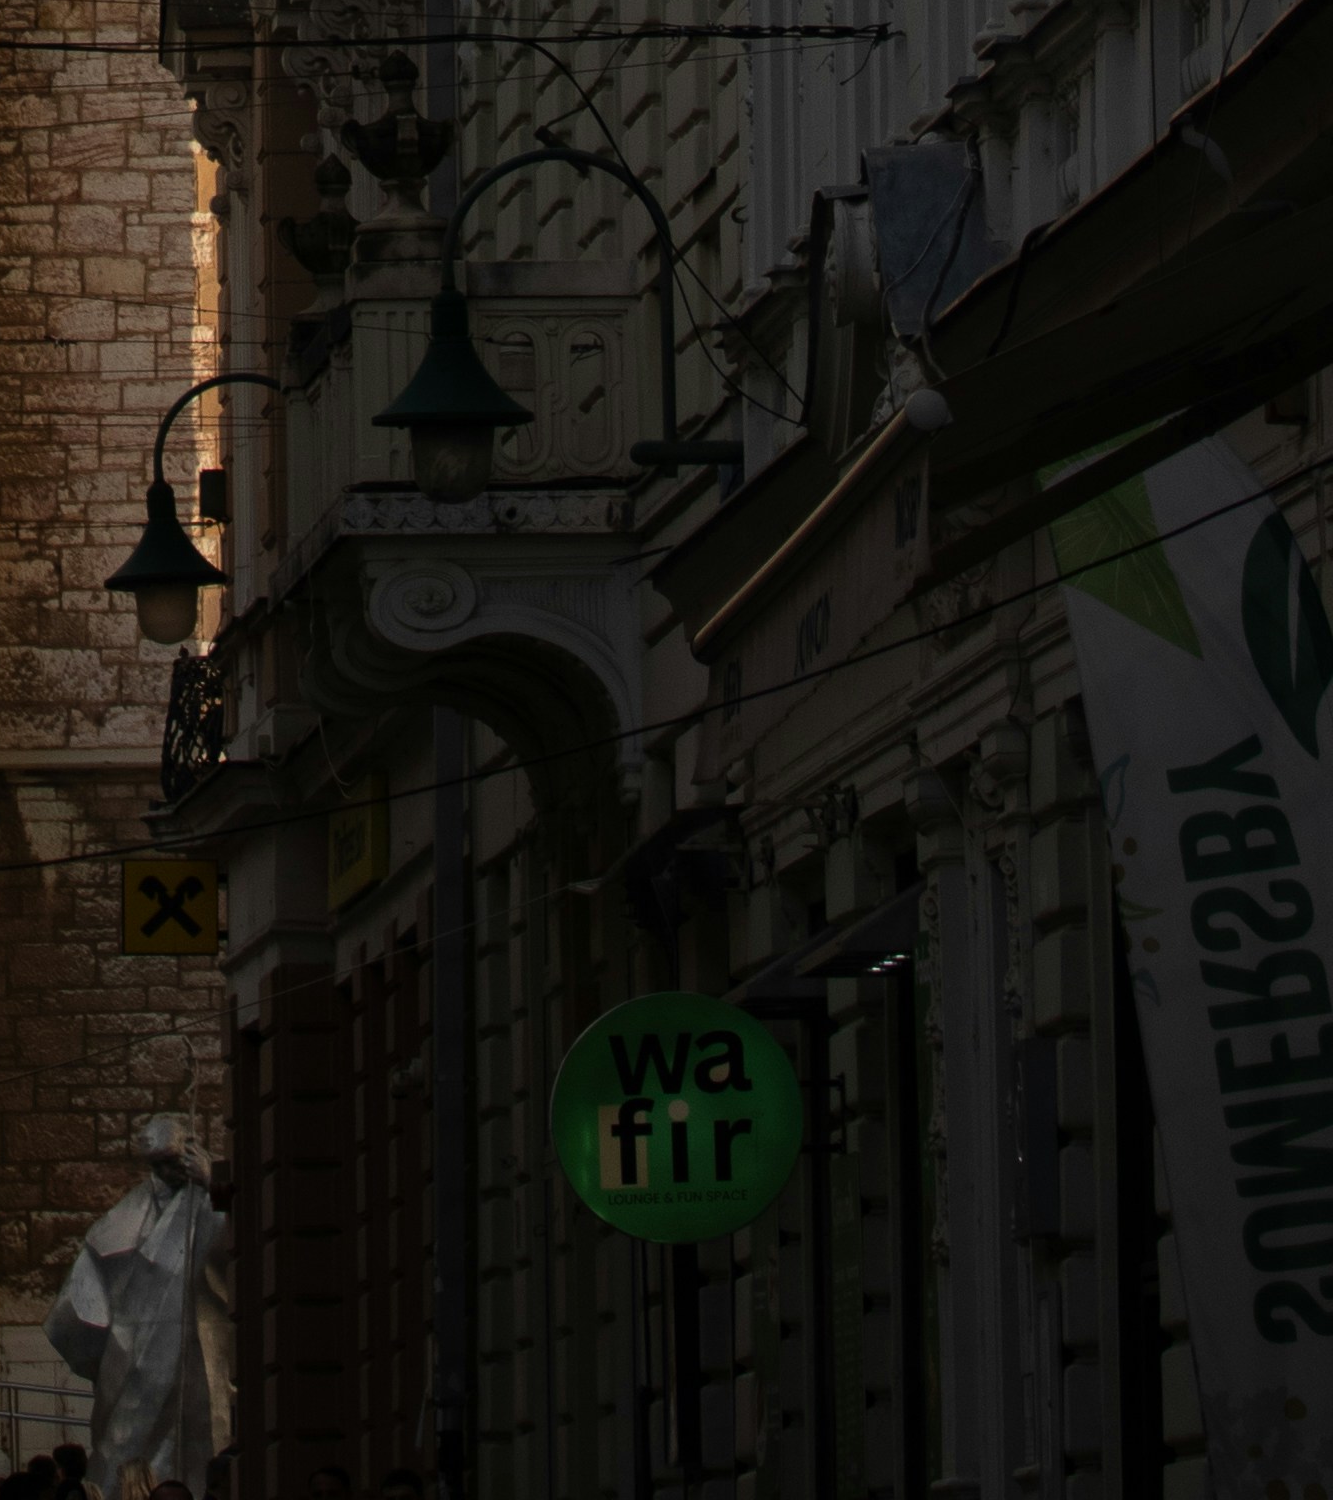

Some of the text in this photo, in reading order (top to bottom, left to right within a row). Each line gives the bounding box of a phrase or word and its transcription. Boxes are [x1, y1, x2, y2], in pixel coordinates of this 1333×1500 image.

[608, 1030, 753, 1096] wa
[611, 1098, 753, 1185] fir
[608, 1189, 749, 1206] LOUNGE & FUN SPACE
